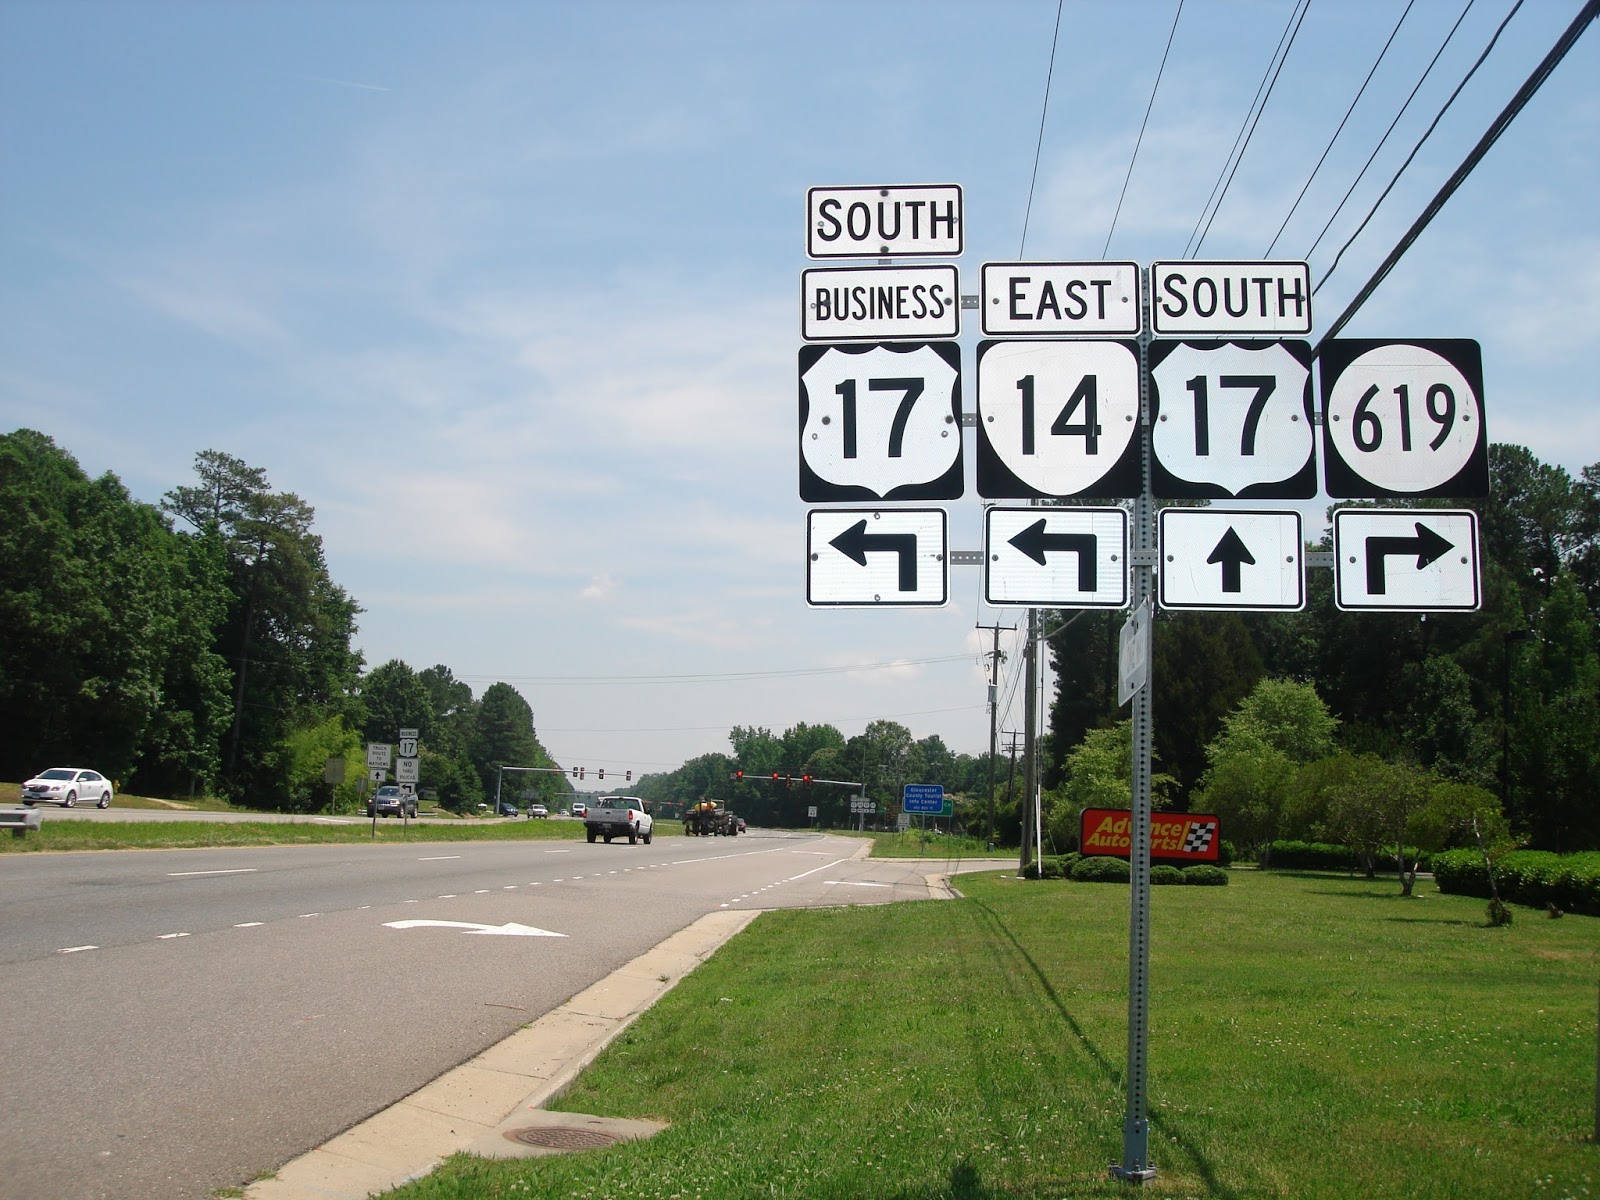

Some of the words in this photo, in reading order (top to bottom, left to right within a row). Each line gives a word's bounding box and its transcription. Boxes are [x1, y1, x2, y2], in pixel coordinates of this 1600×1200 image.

[817, 201, 956, 241] SOUTH
[815, 287, 945, 321] BUSINESS
[1008, 278, 1112, 320] EAST
[1162, 273, 1303, 318] SOUTH
[834, 377, 925, 459] 17
[1016, 374, 1102, 456] 14
[1185, 374, 1277, 457] 17
[1351, 383, 1456, 453] 619
[404, 742, 414, 754] 17
[1085, 833, 1130, 848] Auto
[1096, 816, 1182, 837] Adnce
